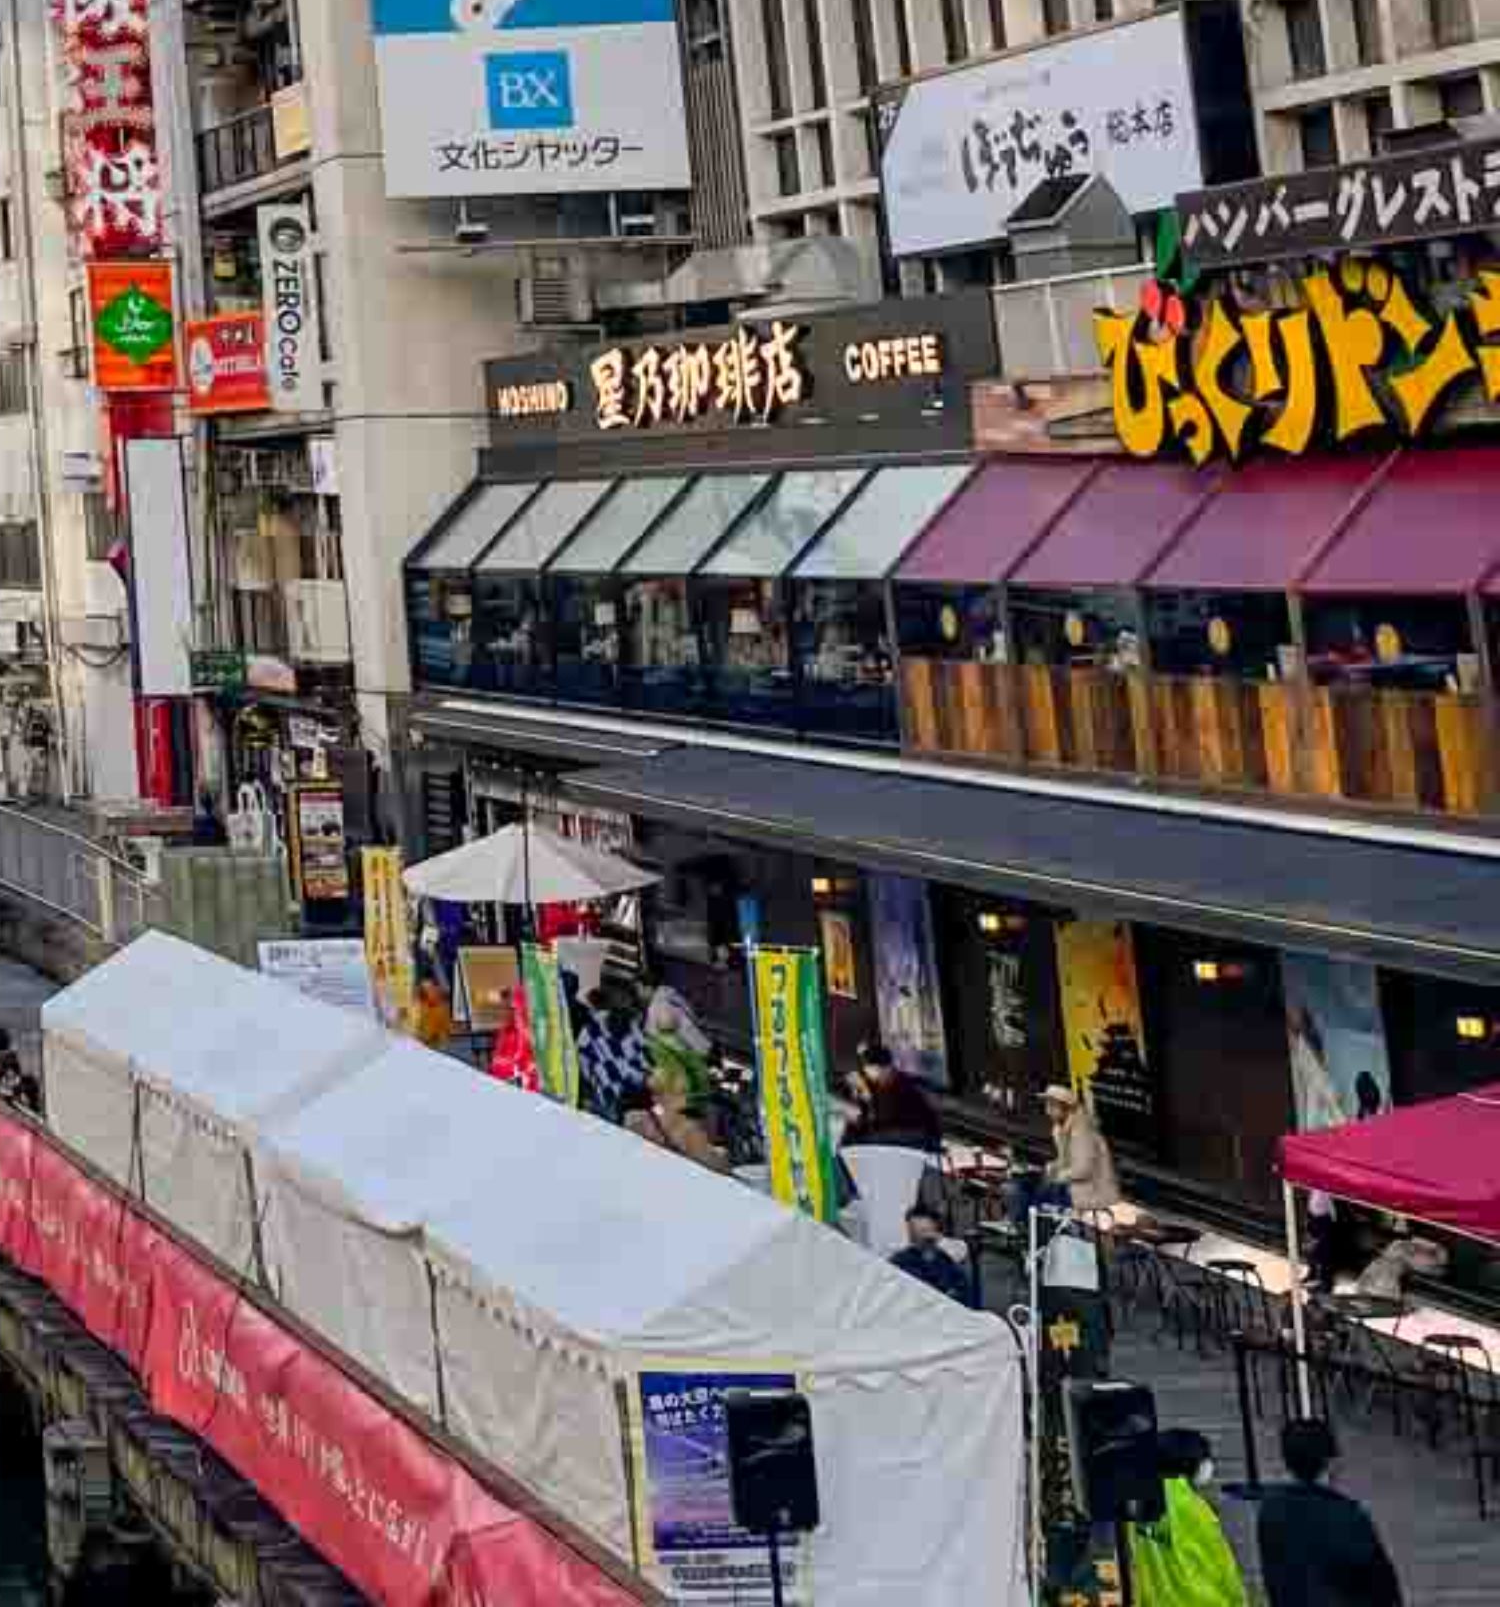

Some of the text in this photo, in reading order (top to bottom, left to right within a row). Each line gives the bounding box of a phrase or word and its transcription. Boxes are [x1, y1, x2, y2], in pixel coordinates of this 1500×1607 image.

[499, 66, 558, 109] BX
[1106, 101, 1176, 145] 総本店
[439, 135, 645, 173] 文化シャッター
[273, 259, 302, 334] ZERO
[590, 320, 802, 429] 星乃珈琲店
[845, 334, 942, 382] COFFEE
